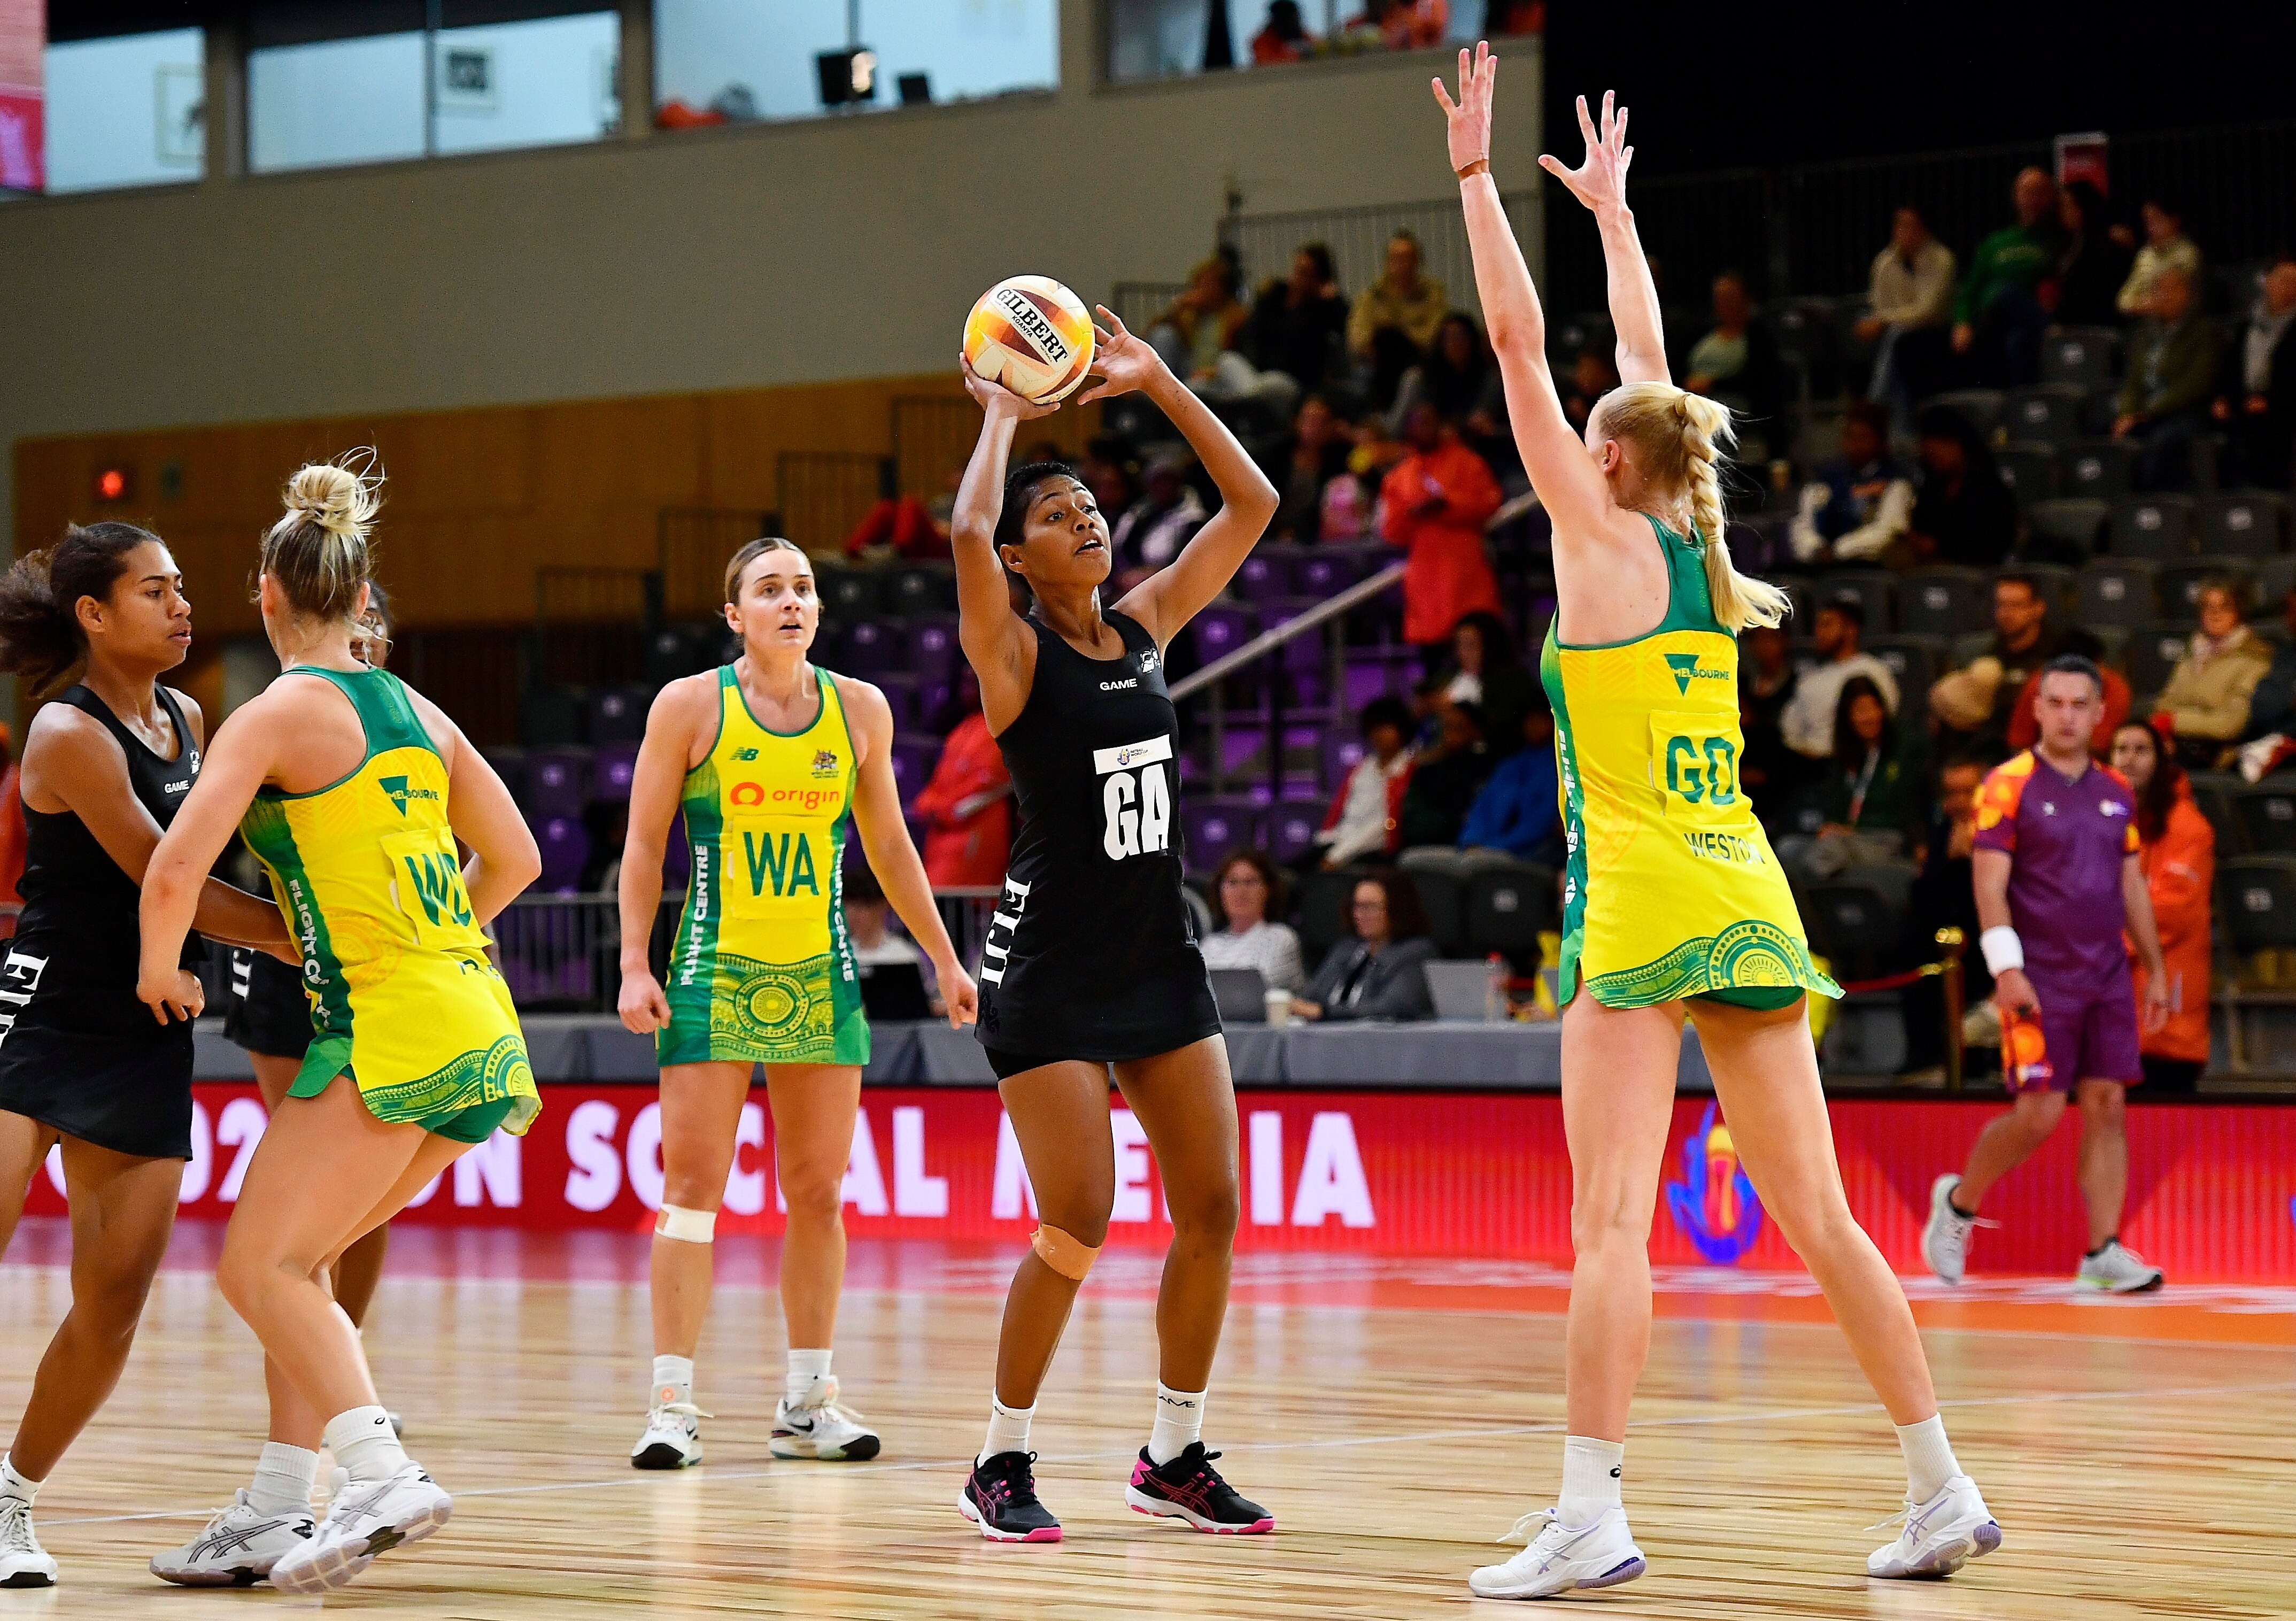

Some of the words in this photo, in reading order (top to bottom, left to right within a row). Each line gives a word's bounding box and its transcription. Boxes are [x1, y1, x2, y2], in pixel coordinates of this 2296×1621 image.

[996, 289, 1069, 363] GILBERT
[1011, 315, 1033, 338] KGANYA
[1100, 678, 1138, 691] GAME
[165, 779, 190, 793] GAME
[772, 790, 839, 810] origin
[1666, 735, 1736, 805] GO
[1103, 763, 1170, 861] GA
[693, 844, 709, 921] CENTRE
[743, 831, 819, 897] WA
[289, 879, 317, 955] FLIGHT
[980, 873, 1032, 989] FIJI
